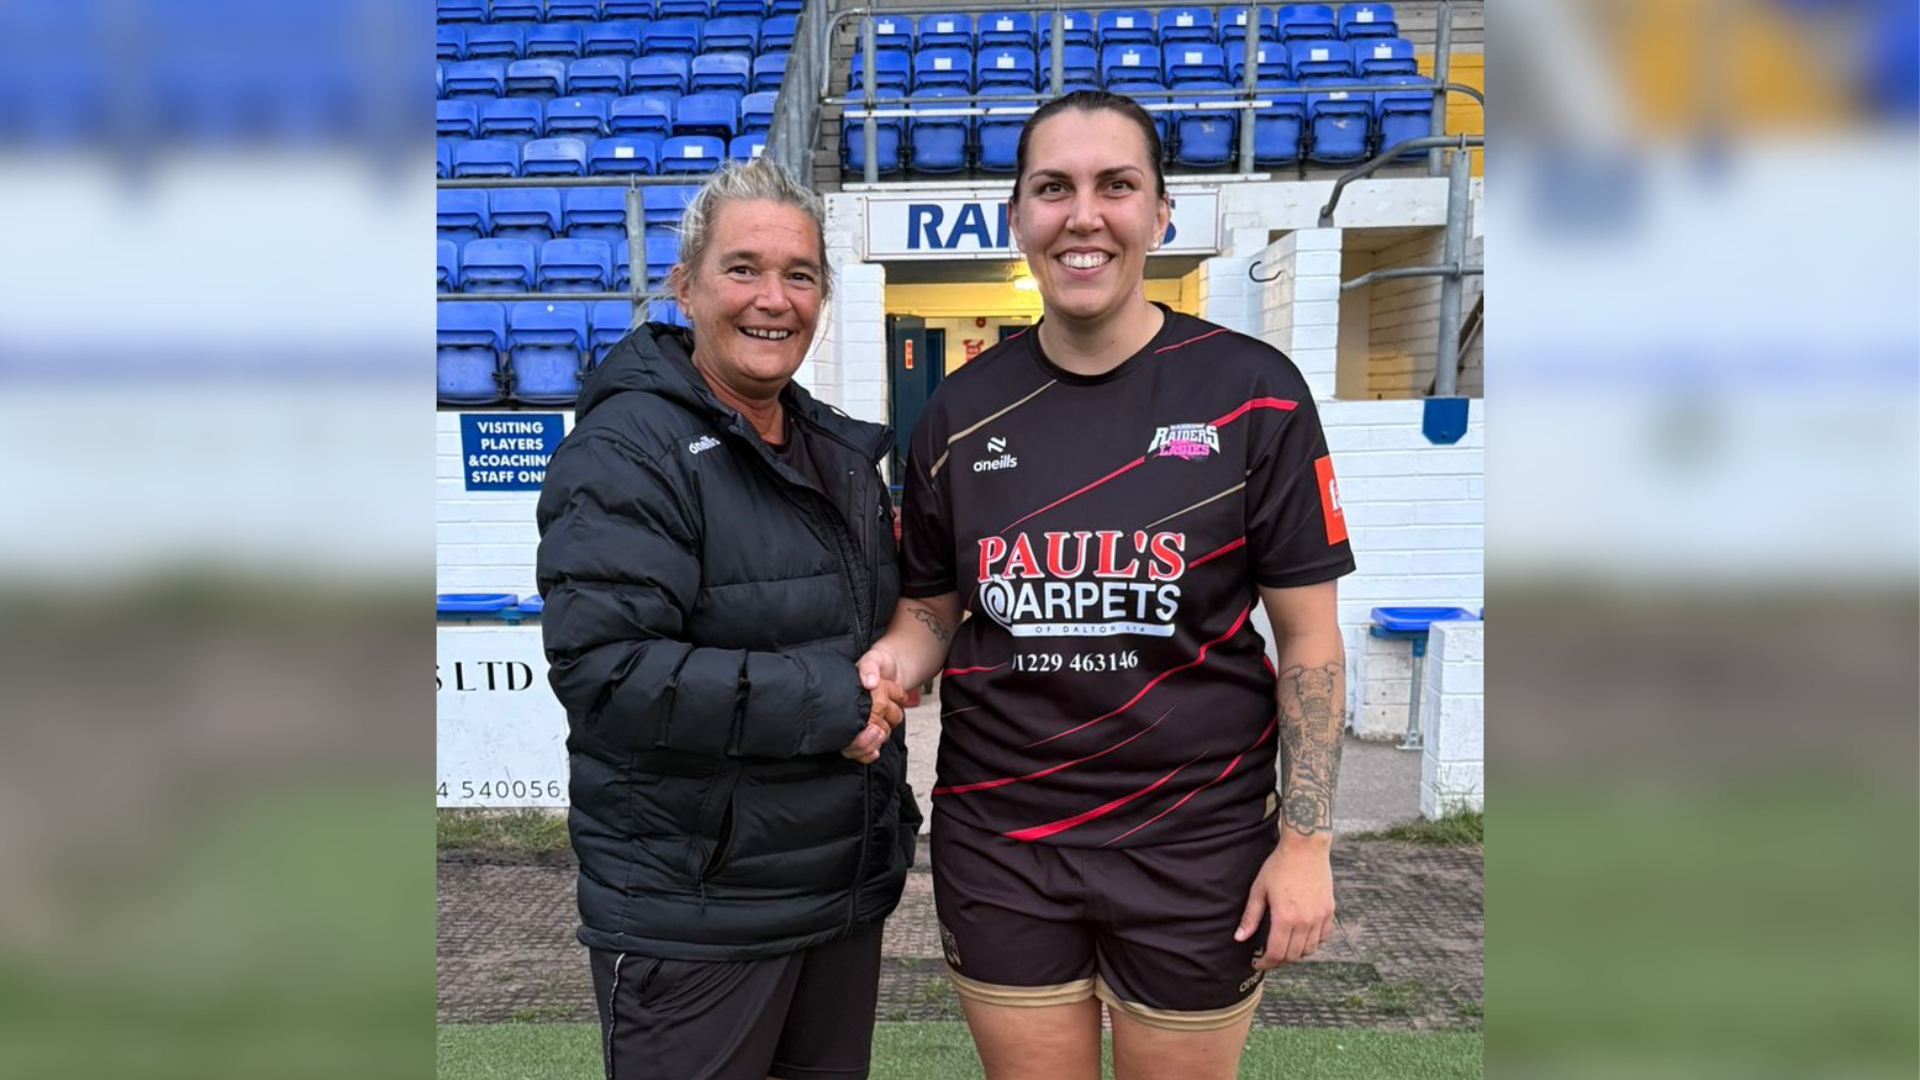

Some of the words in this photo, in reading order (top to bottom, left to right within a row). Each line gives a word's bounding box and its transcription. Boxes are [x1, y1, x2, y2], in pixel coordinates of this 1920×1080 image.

[477, 421, 544, 434] VISITING
[480, 438, 544, 450] PLAYERS
[1147, 425, 1220, 454] RAIDERS
[472, 470, 514, 483] STAFF
[517, 470, 546, 483] ON
[978, 531, 1185, 583] PAUL'S
[1035, 625, 1051, 633] OF
[1063, 625, 1116, 633] DALTON
[1069, 650, 1138, 672] 463146
[454, 661, 533, 691] LTD
[462, 780, 560, 799] 540056
